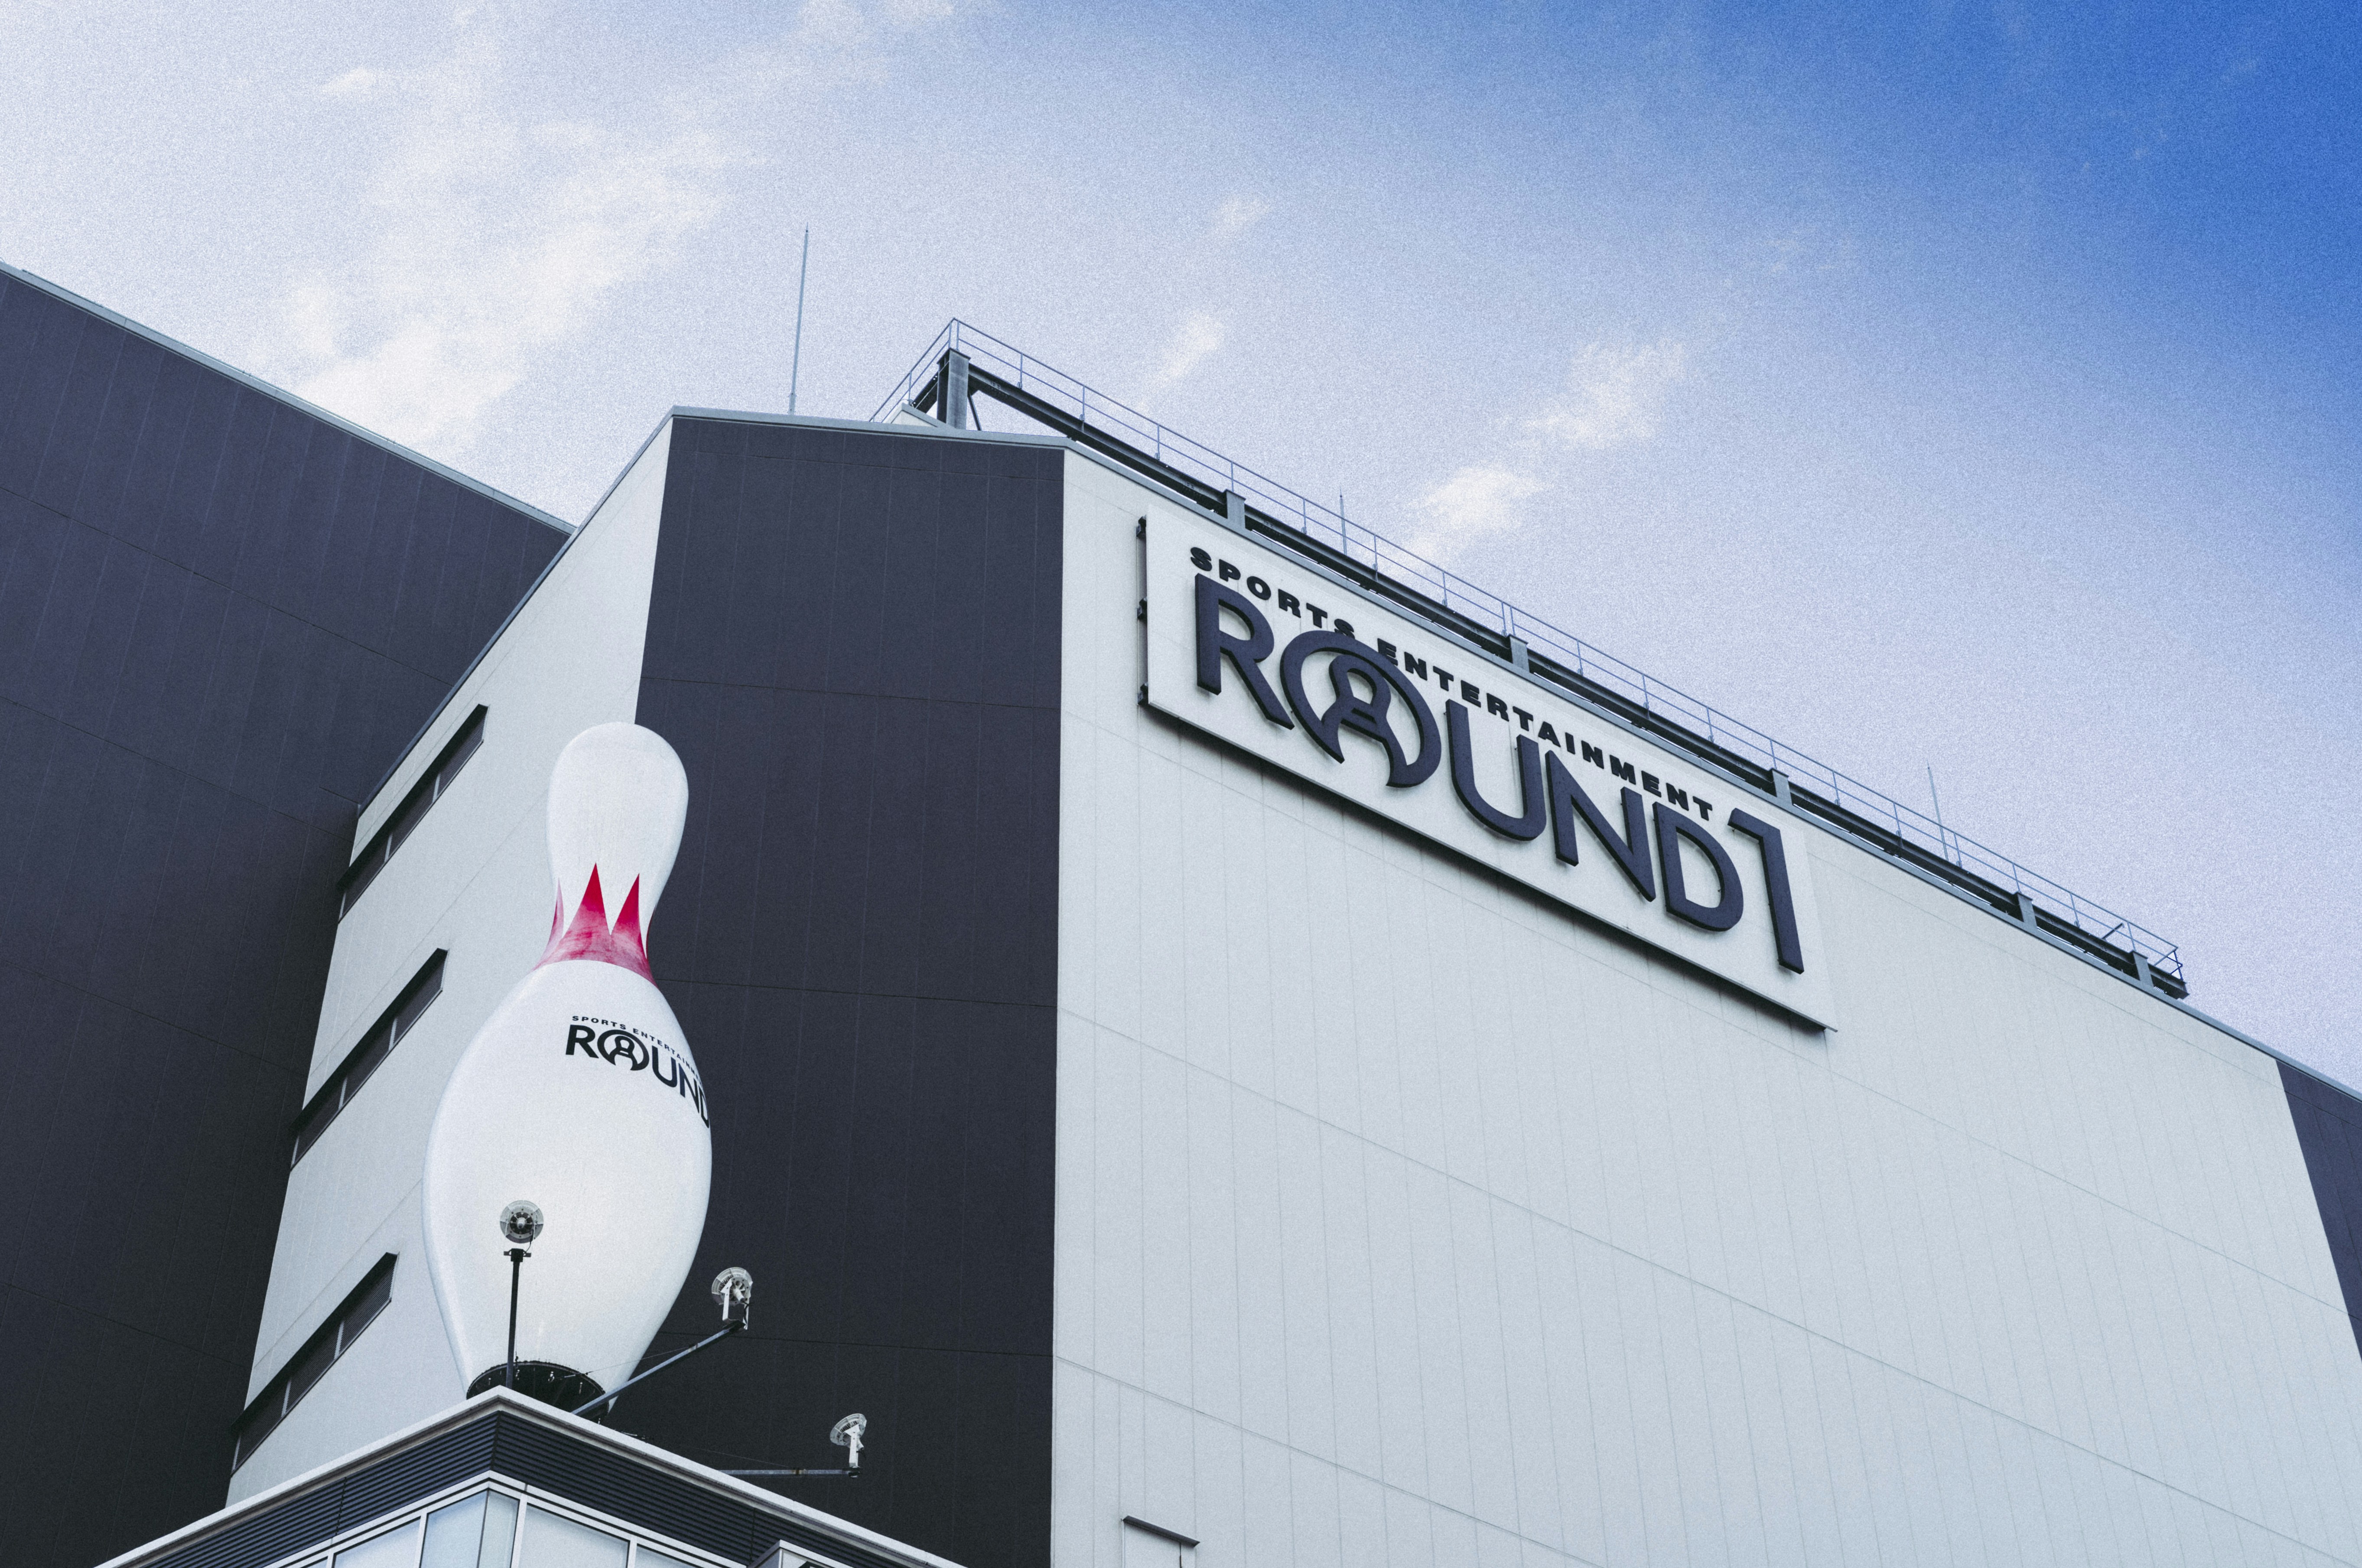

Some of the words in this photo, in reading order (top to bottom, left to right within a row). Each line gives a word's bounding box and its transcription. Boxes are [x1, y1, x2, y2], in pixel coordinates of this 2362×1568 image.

[1190, 547, 1355, 639] SPORTS
[1377, 651, 1713, 821] ENTERTAINMENT
[1195, 573, 1805, 975] ROUND1
[572, 1015, 627, 1030] SPORTS
